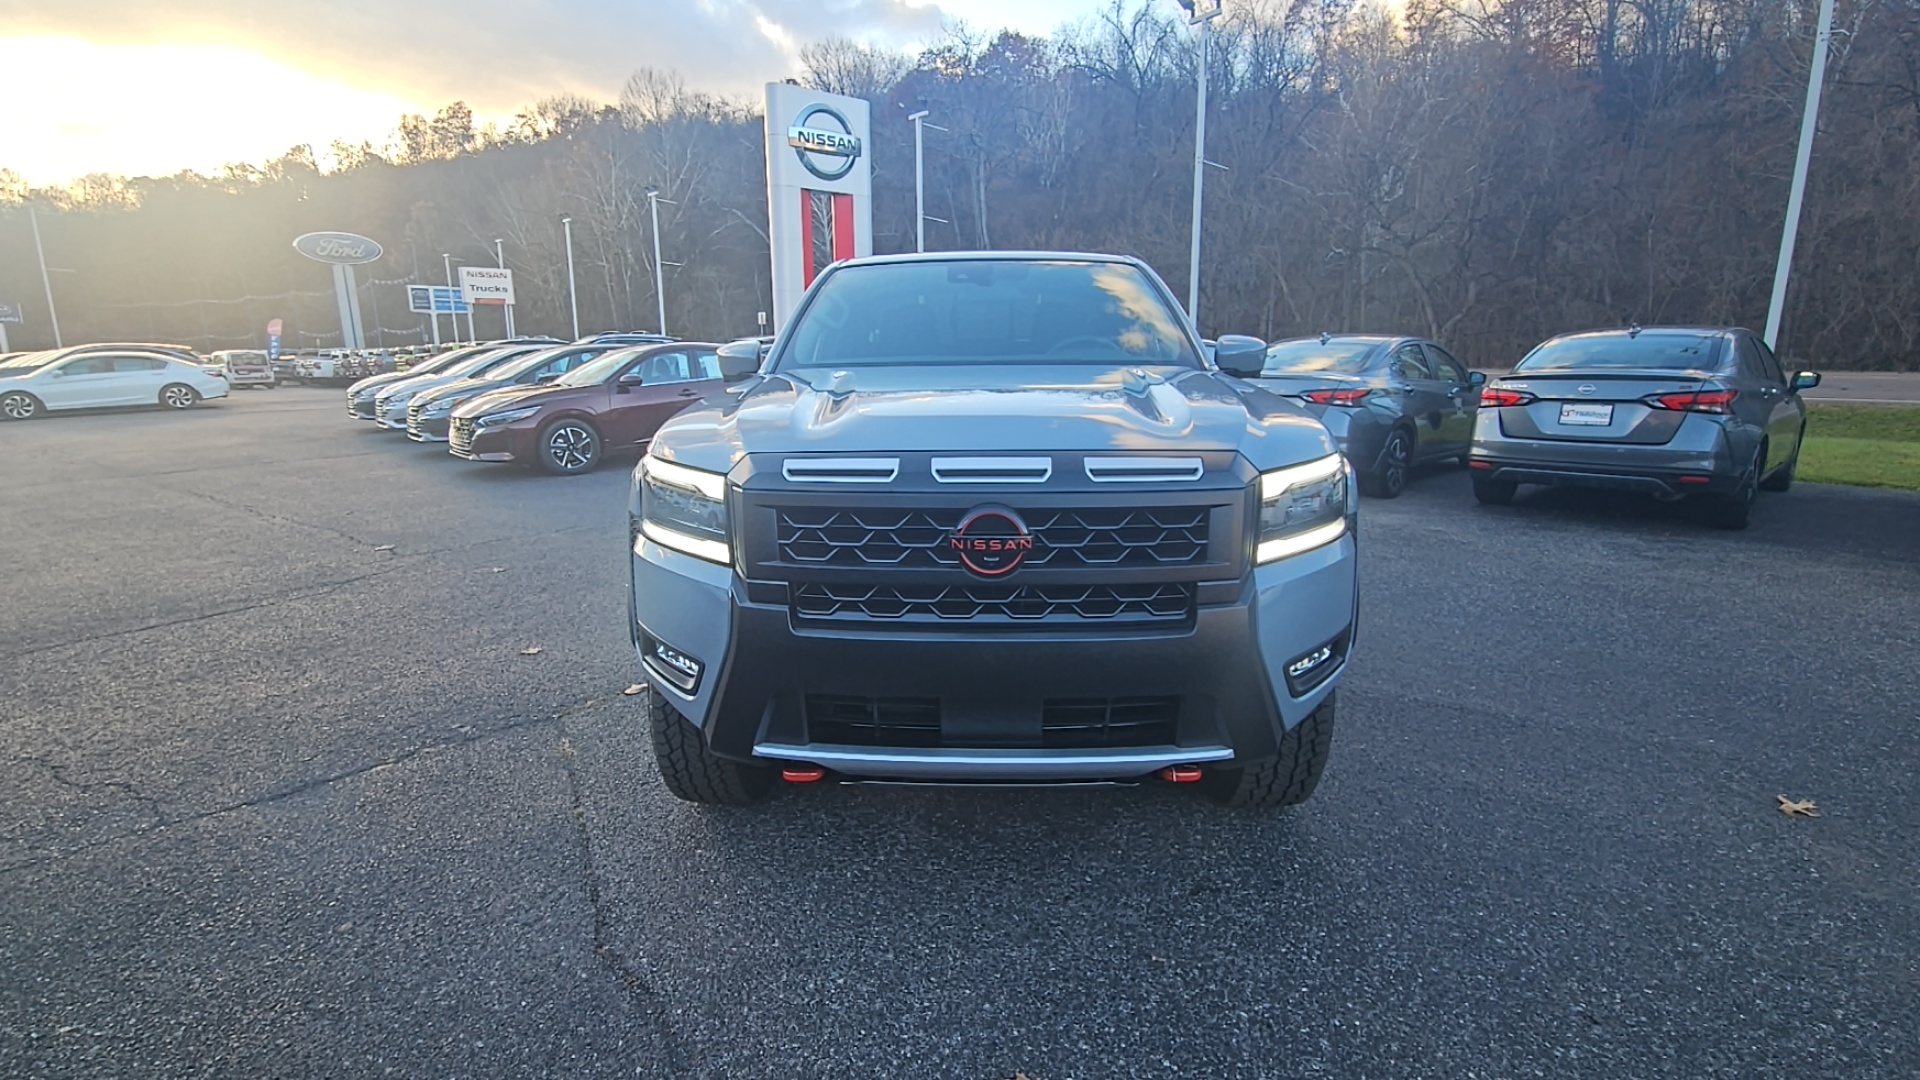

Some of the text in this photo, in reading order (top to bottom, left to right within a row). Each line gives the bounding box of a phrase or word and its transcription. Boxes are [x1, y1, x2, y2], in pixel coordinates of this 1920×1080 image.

[798, 130, 857, 151] NISSAN
[316, 238, 366, 258] Ford
[466, 270, 508, 279] NISSAN
[469, 284, 509, 293] Trucks
[951, 538, 1033, 551] NISSAN
